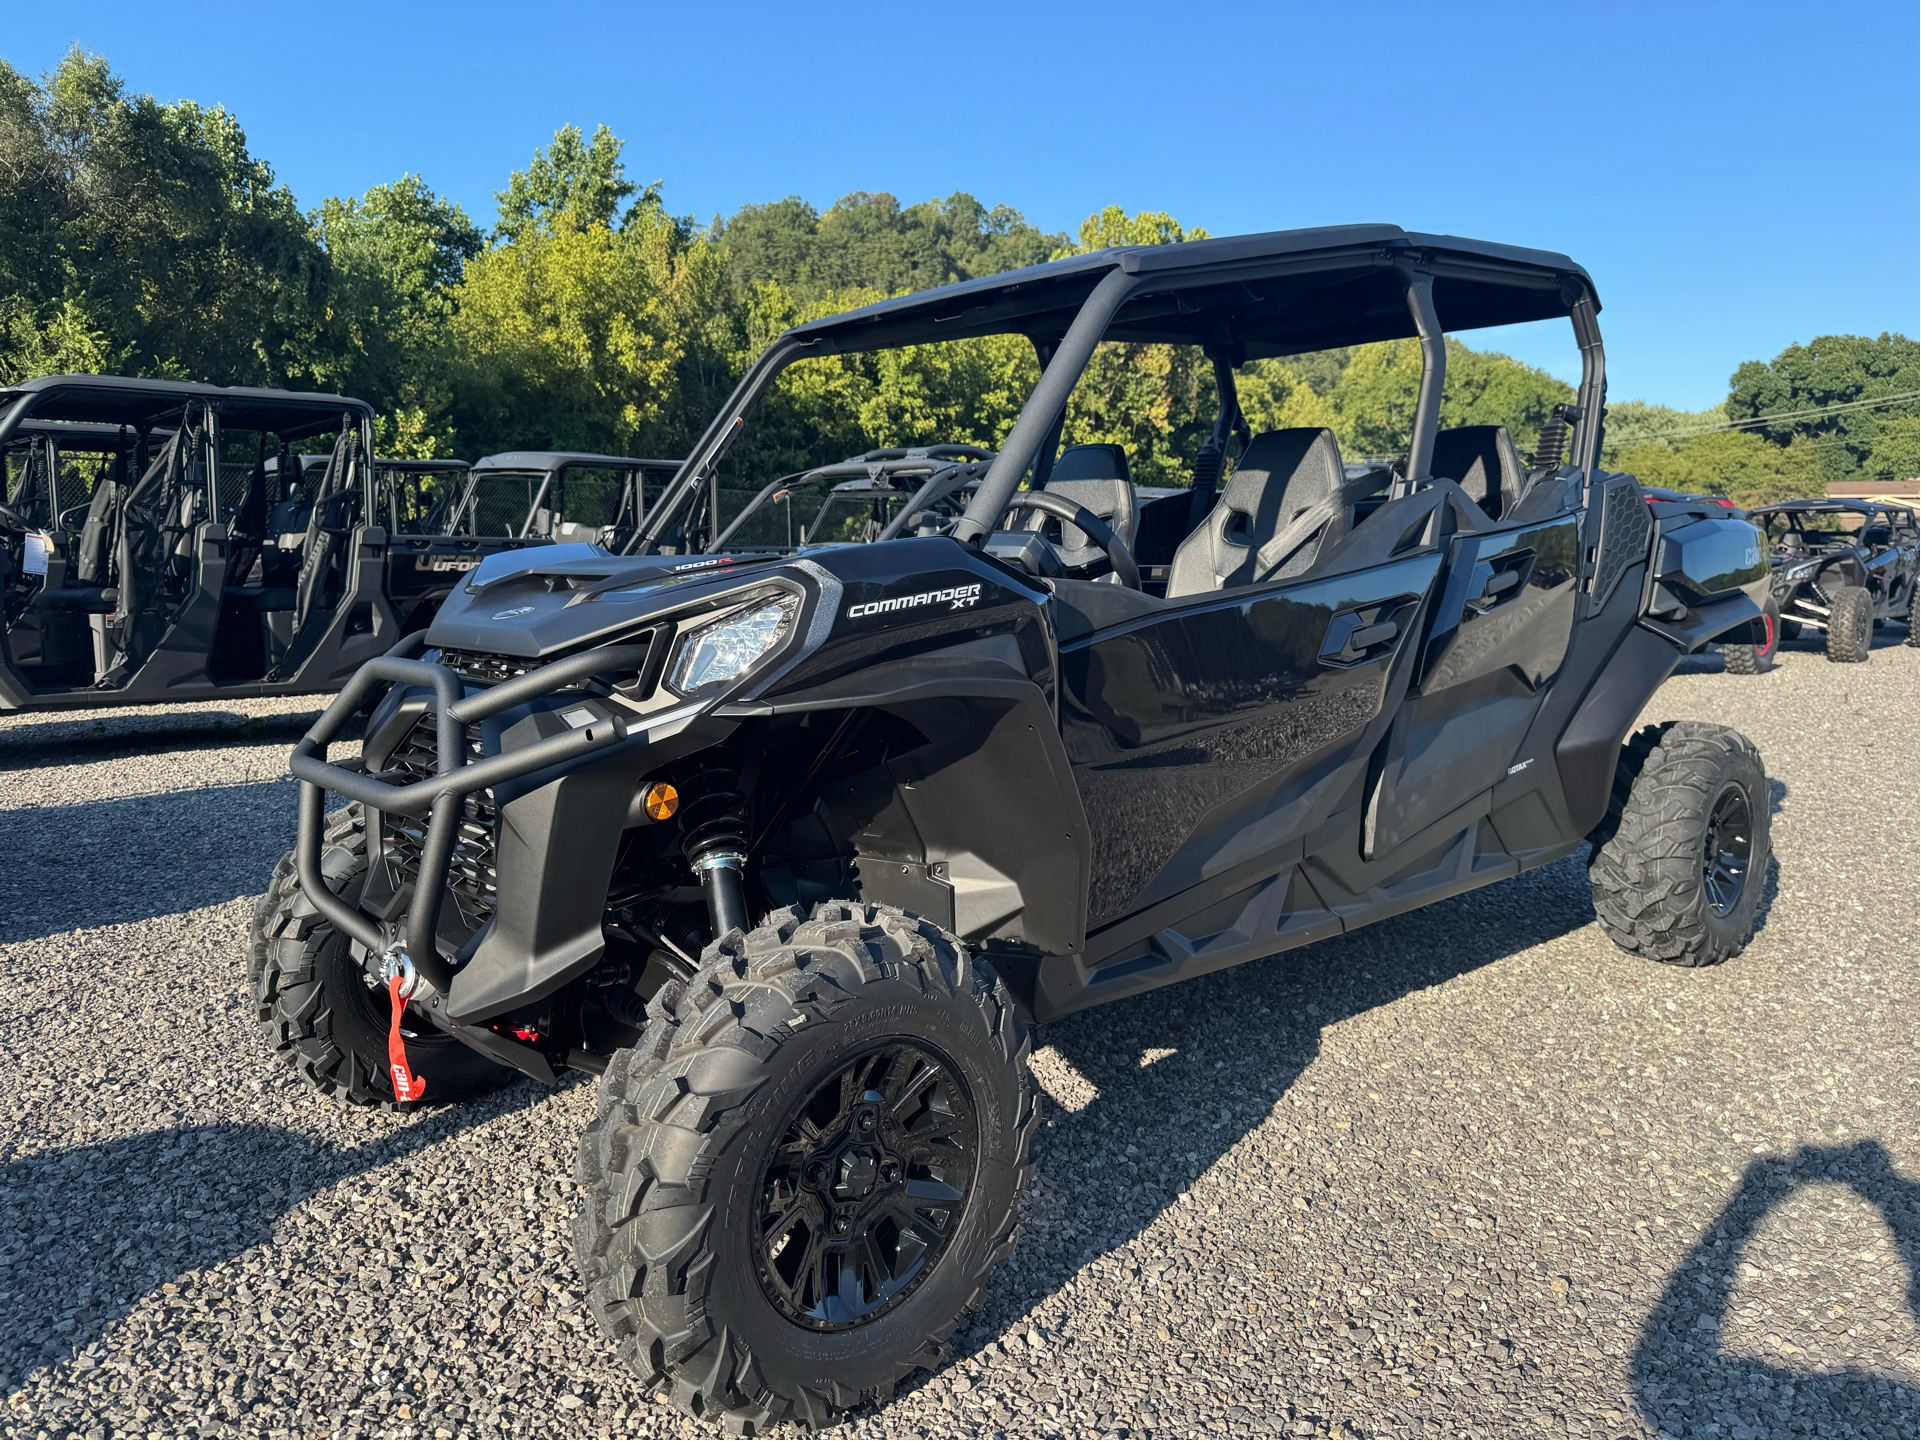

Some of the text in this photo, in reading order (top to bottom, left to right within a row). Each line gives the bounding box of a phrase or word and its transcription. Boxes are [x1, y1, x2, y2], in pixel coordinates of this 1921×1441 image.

[675, 558, 733, 571] 1000R
[849, 583, 981, 618] COMMANDER
[950, 596, 980, 610] XT
